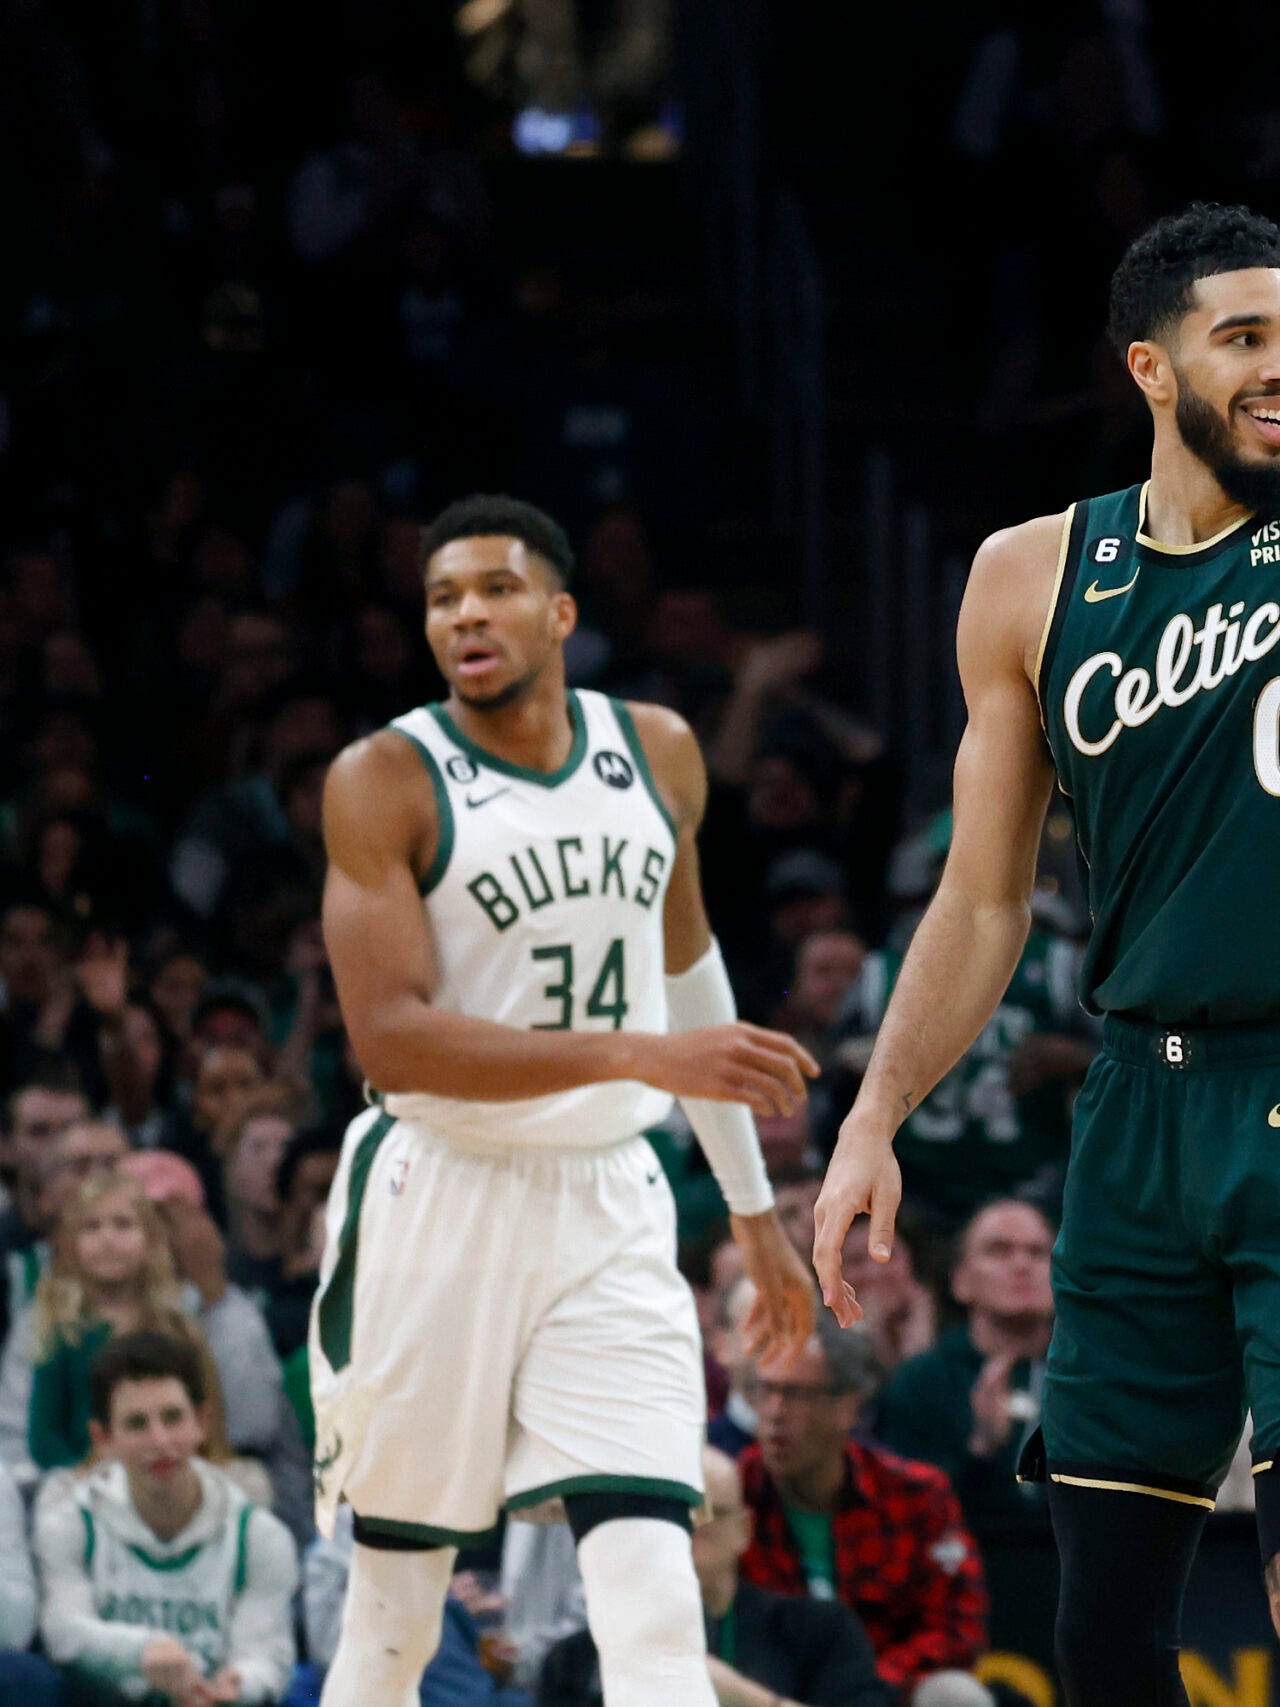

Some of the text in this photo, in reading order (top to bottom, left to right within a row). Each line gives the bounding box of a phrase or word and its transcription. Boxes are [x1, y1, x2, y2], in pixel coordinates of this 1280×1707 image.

[1095, 537, 1121, 563] 6
[466, 837, 665, 933] BUCKS
[530, 938, 629, 1031] 34
[1166, 1035, 1184, 1063] 6
